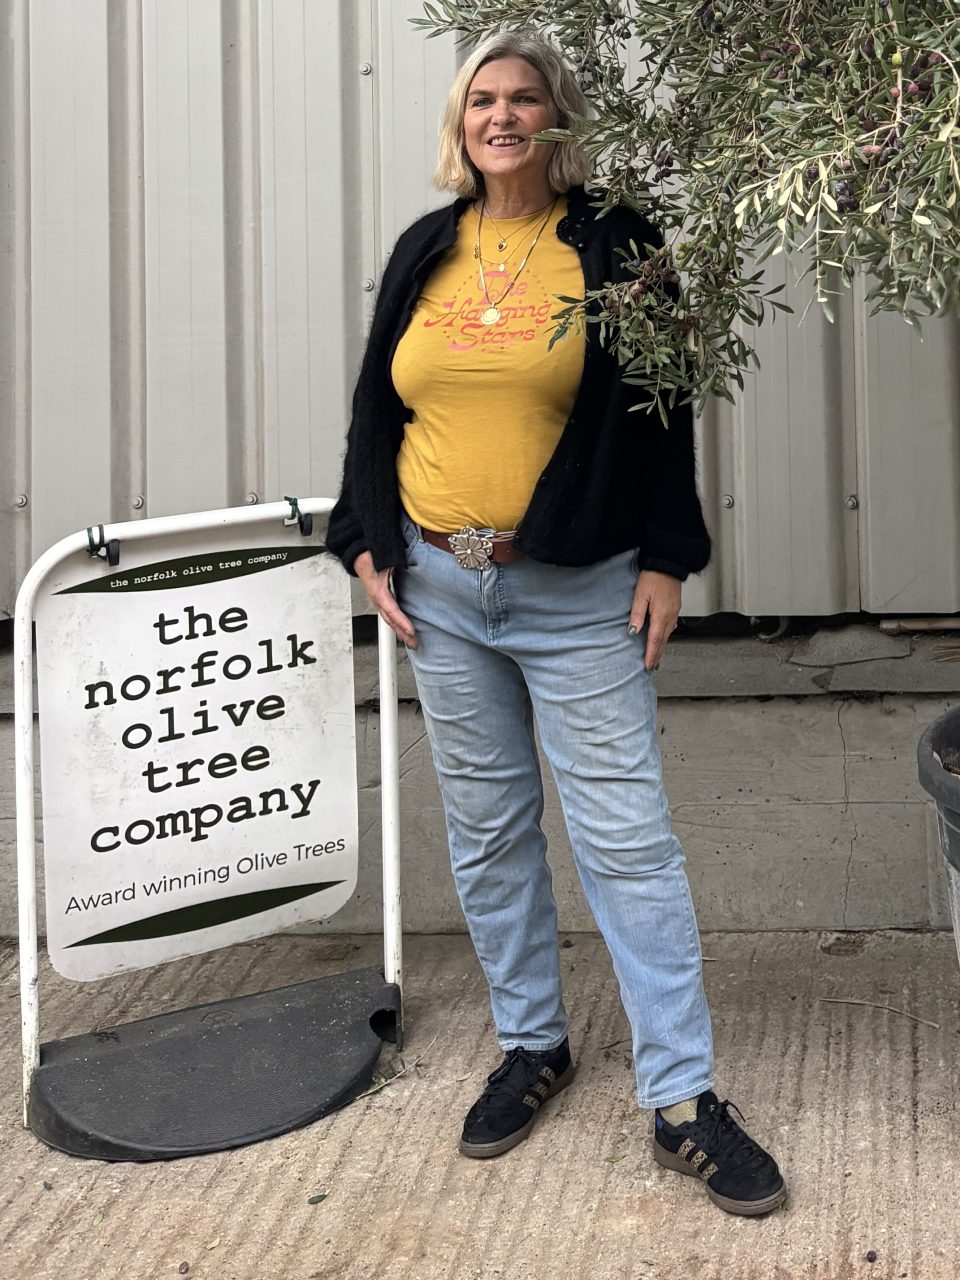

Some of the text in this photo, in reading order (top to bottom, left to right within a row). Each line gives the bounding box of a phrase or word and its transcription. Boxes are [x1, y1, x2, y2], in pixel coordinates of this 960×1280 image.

[423, 297, 552, 327] Haging
[448, 322, 536, 351] Stars
[109, 552, 289, 588] the norfolk olive tree company
[153, 605, 248, 645] the
[84, 633, 317, 710] norfolk
[121, 694, 286, 750] olive
[141, 744, 271, 794] tree
[90, 779, 321, 853] company
[65, 837, 346, 915] Award winning Olive Trees
